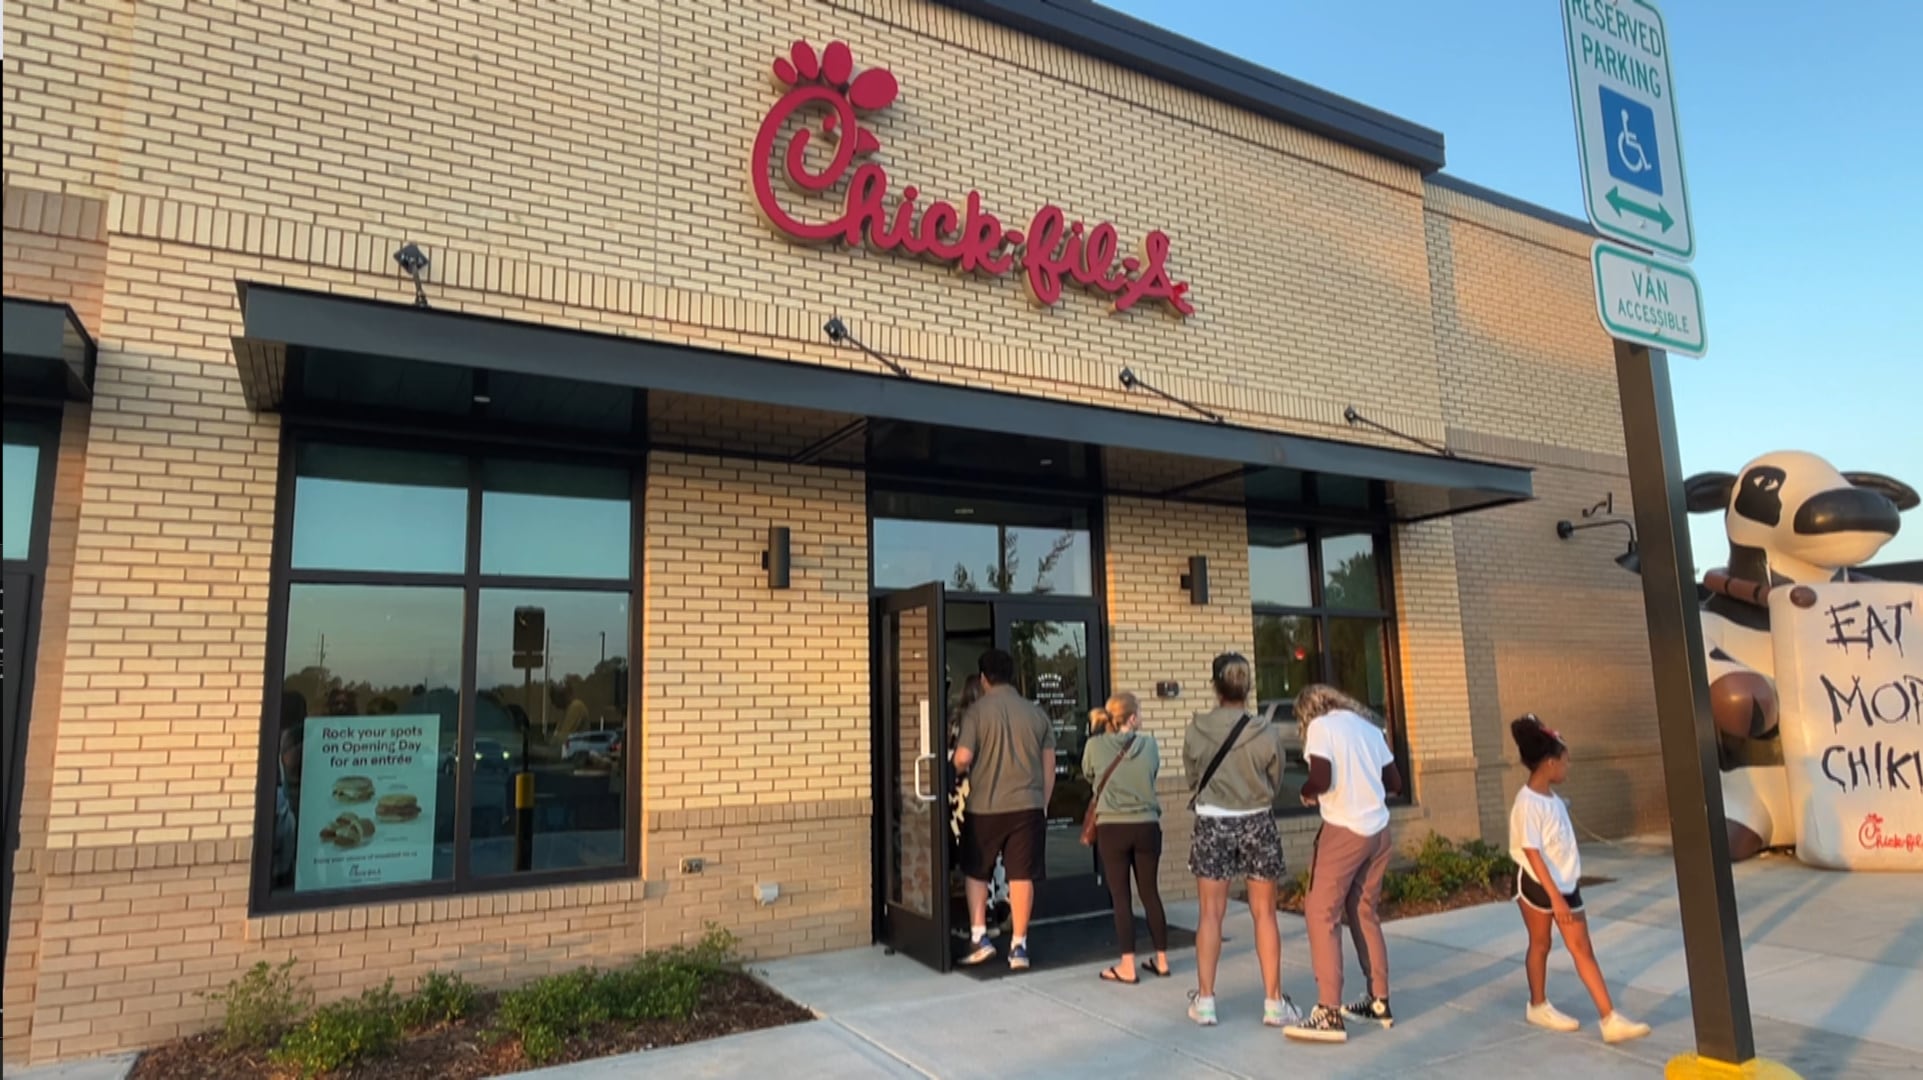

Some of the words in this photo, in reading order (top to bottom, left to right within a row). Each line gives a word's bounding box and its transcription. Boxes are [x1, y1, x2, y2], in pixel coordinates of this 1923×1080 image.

[1581, 32, 1661, 99] PARKING
[750, 40, 1195, 315] Chick-fil-A
[1631, 270, 1669, 305] VAN
[1618, 297, 1690, 334] ACCESSIBLE
[1824, 600, 1913, 660] EAT
[322, 726, 354, 740] Rock
[358, 728, 386, 741] your
[391, 725, 423, 740] spots
[322, 743, 339, 754] on
[342, 740, 396, 754] Opening
[399, 739, 422, 753] Day
[330, 756, 349, 768] for
[352, 757, 368, 767] an
